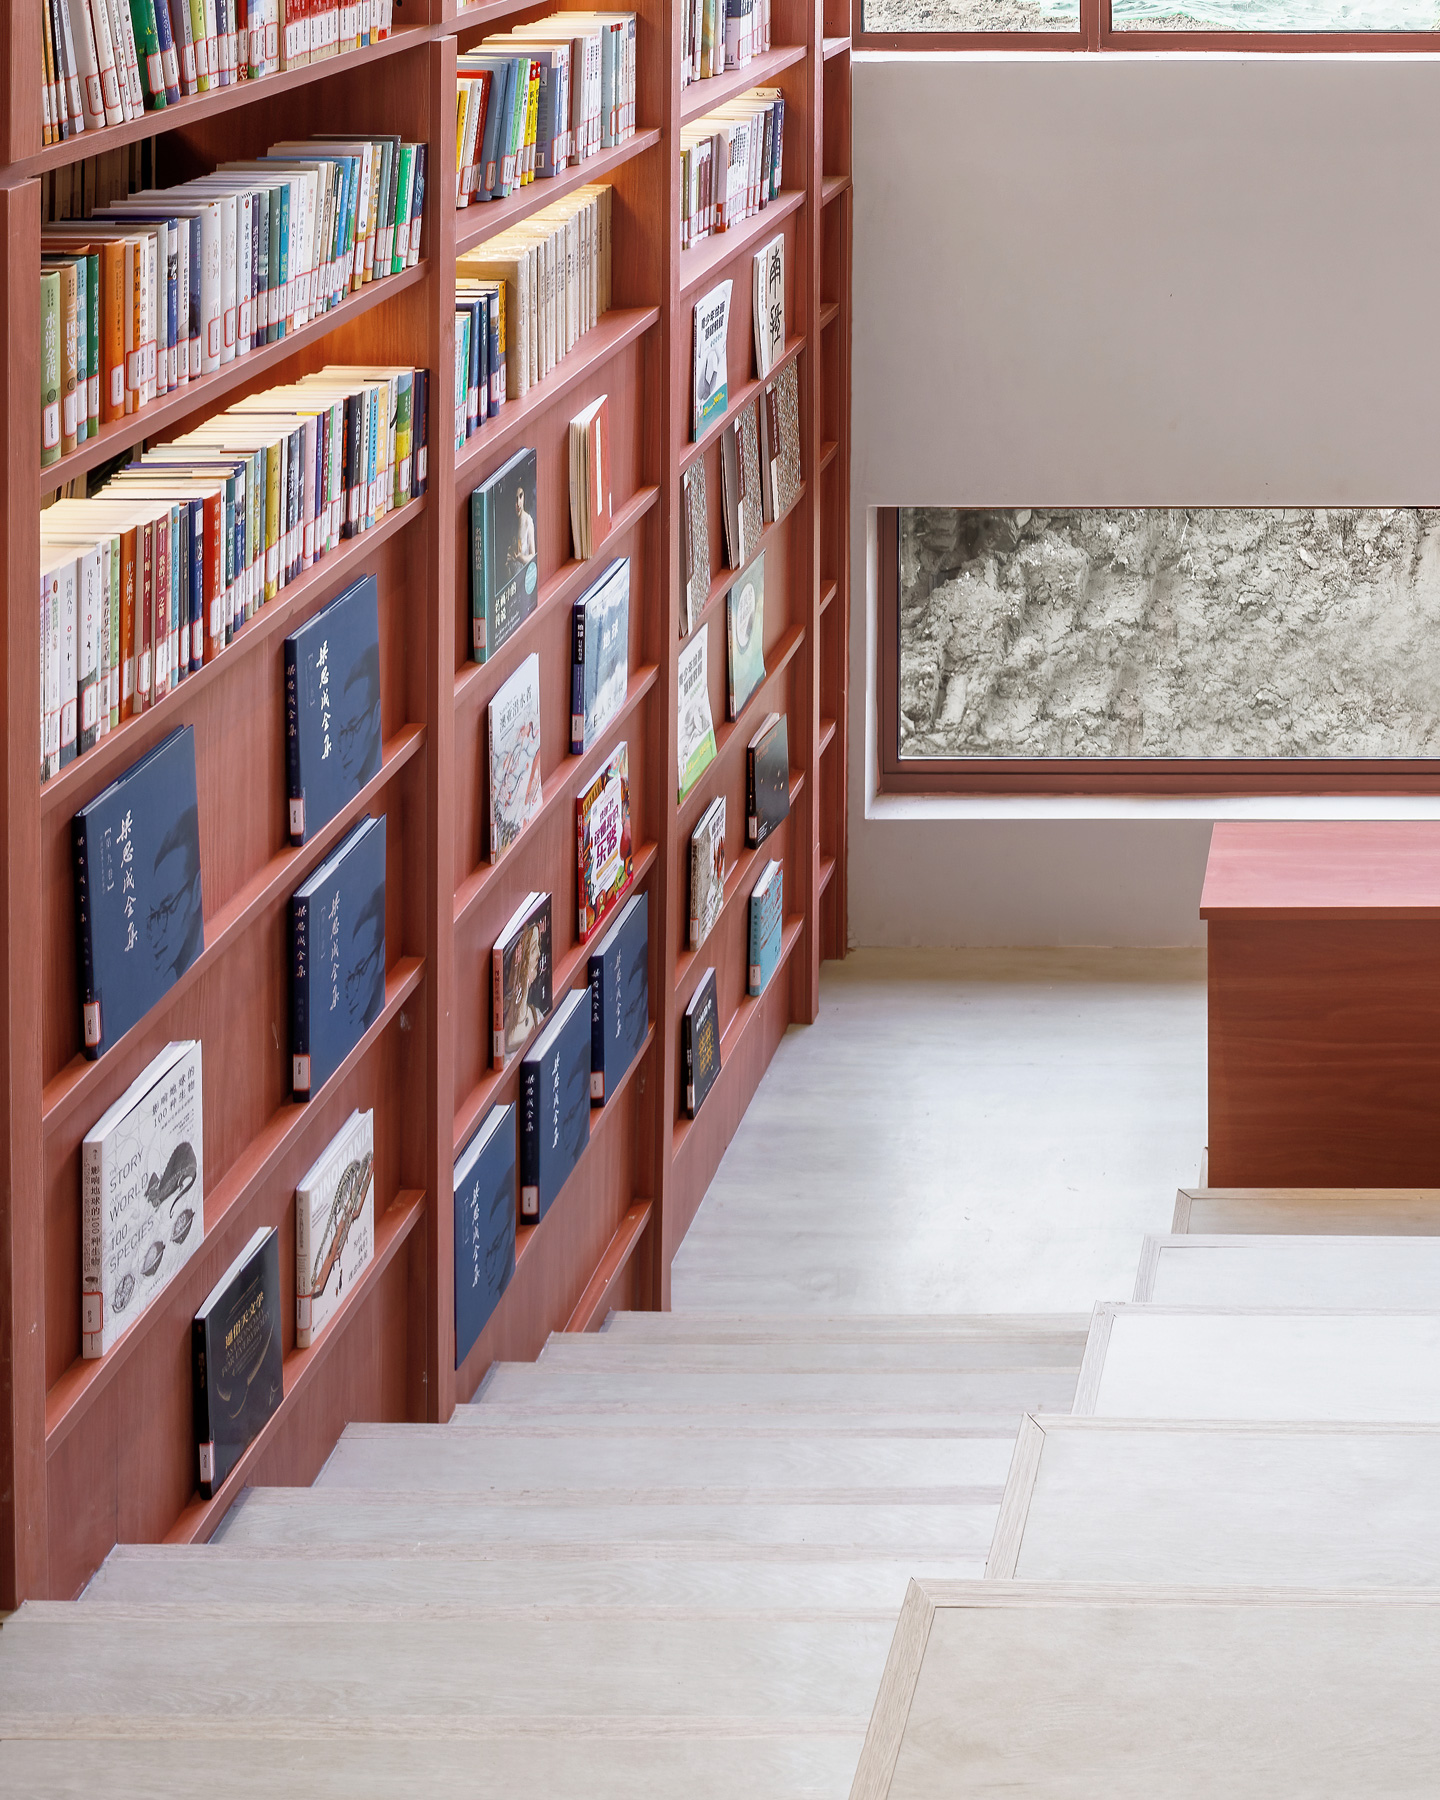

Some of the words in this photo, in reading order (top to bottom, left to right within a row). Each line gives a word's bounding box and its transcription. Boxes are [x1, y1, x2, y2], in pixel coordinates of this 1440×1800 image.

[46, 311, 55, 383] 水浒全传
[66, 303, 75, 372] 三国演义
[316, 640, 332, 760] 梁思成全集
[596, 826, 617, 868] 乐器
[117, 809, 138, 952] 梁思成全集
[295, 905, 306, 978] 梁思成全集
[328, 890, 341, 1011] 梁思成全集
[152, 1065, 195, 1117] 影响地球的
[109, 1172, 150, 1222] WORLD
[110, 1148, 144, 1193] STORY
[110, 1224, 128, 1250] 100
[110, 1219, 155, 1273] SPECIES
[226, 1291, 264, 1349] 通俗天文学
